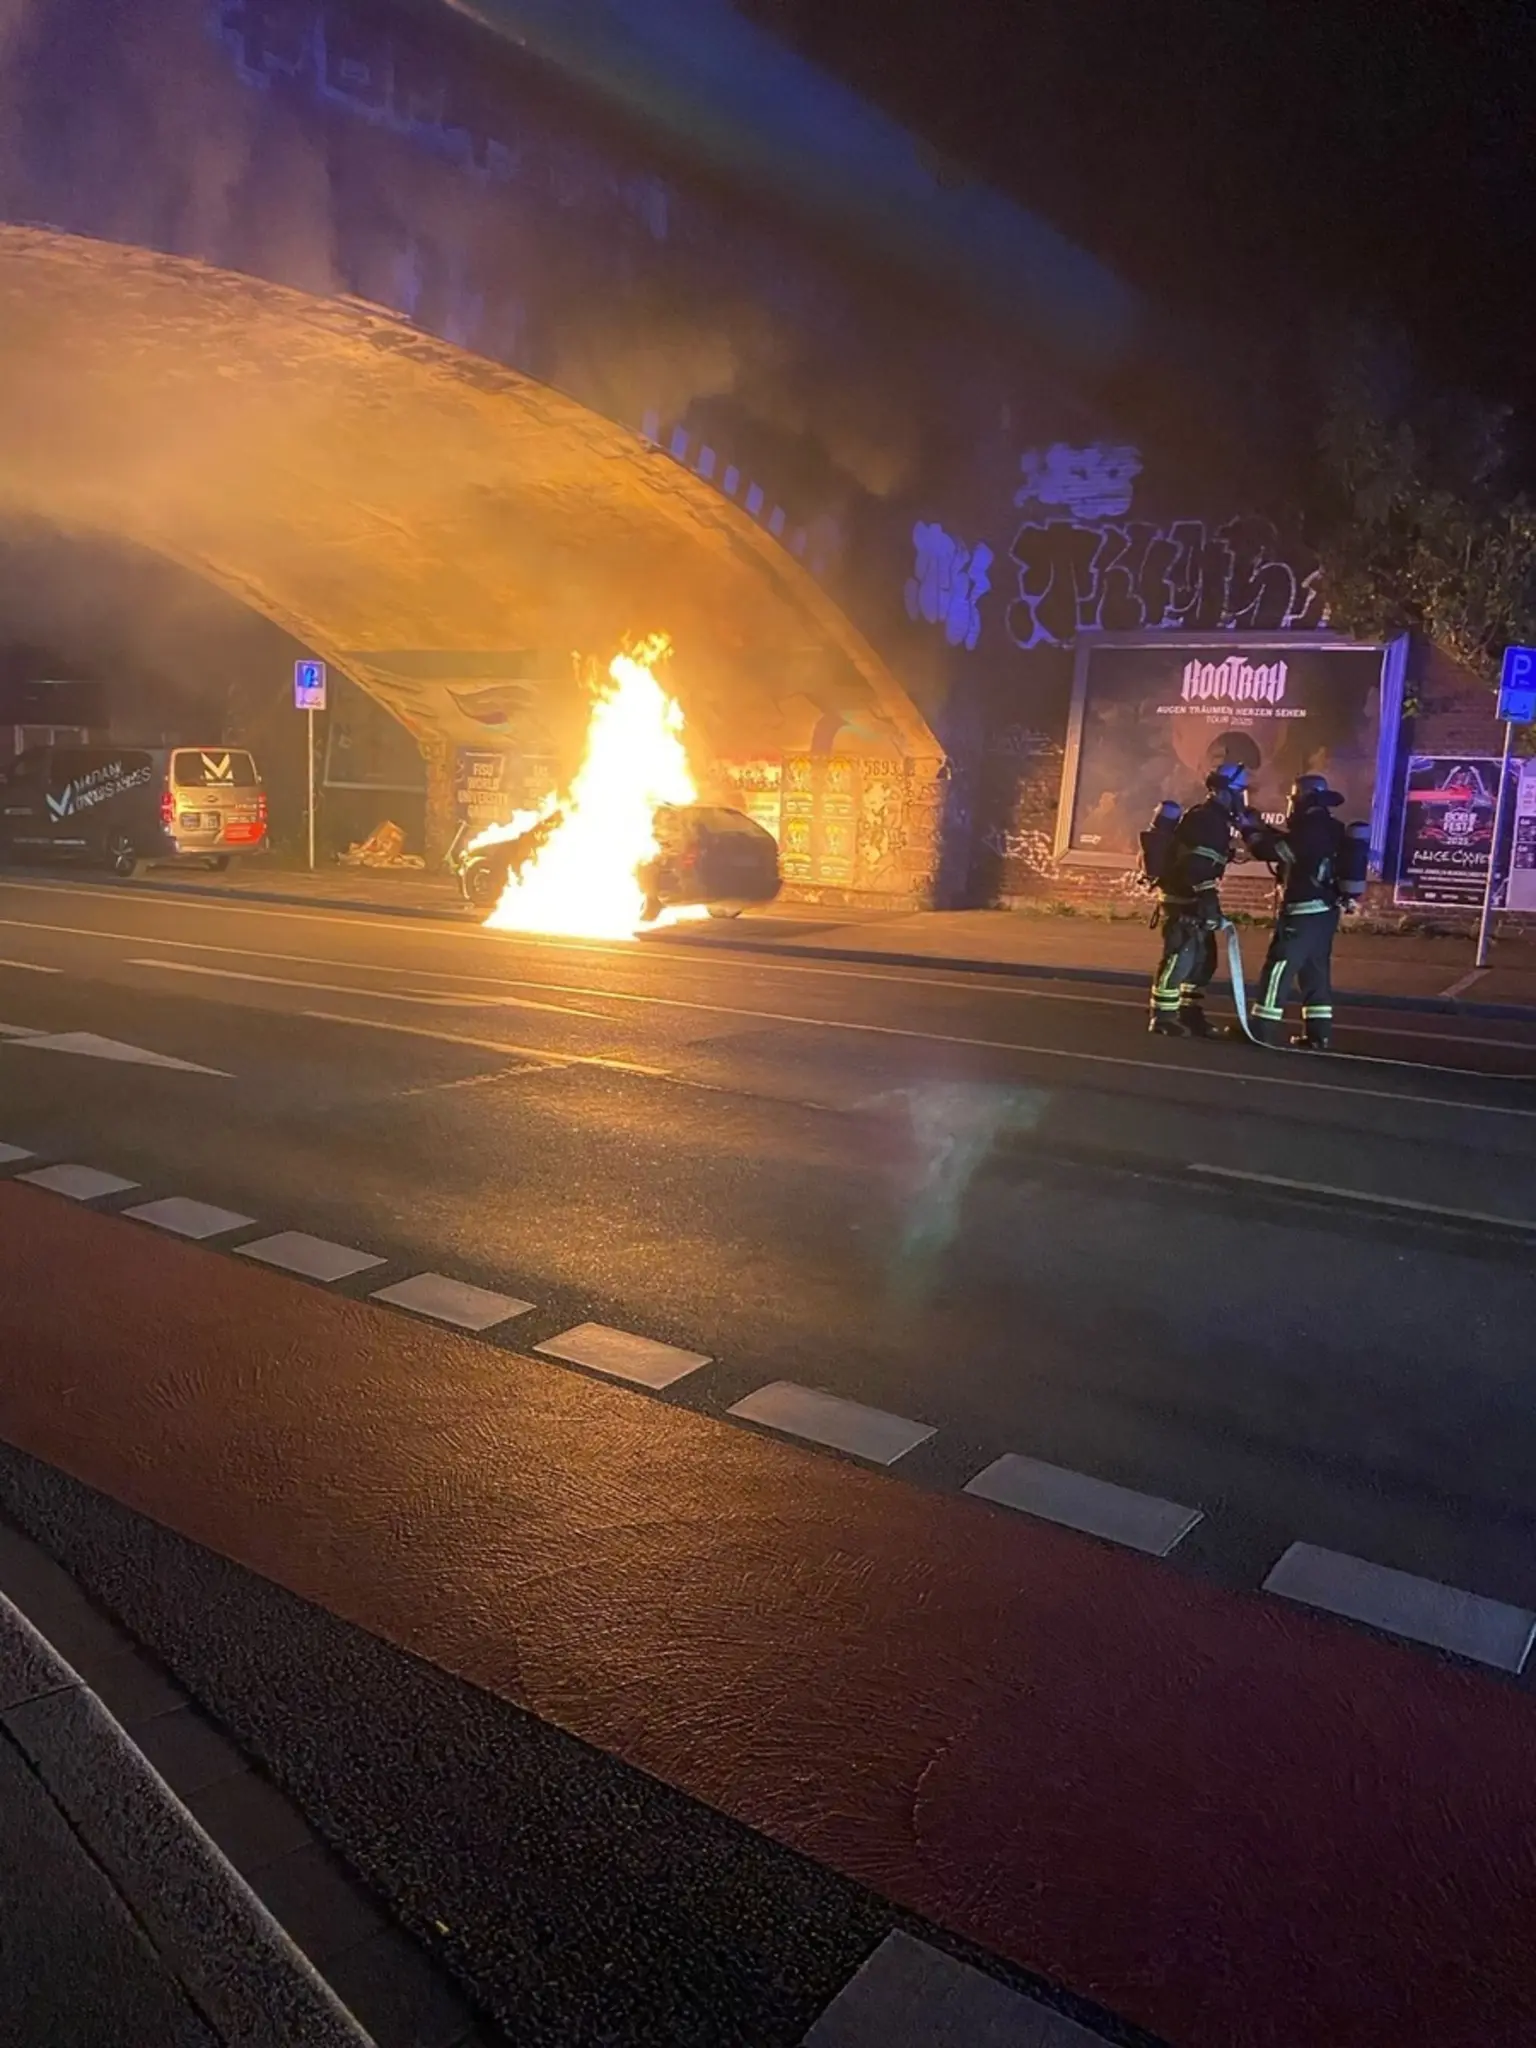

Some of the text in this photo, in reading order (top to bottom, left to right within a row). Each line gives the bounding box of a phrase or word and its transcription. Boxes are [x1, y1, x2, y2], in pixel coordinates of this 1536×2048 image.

[1511, 654, 1532, 687] P
[1156, 705, 1186, 715] AUGEN
[1235, 707, 1273, 717] HERZEN
[1275, 708, 1307, 718] SEHEN
[1206, 715, 1229, 725] TOUR
[467, 776, 500, 791] WORLD
[458, 789, 508, 806] UNIVERSITY
[1412, 849, 1450, 866] ALICE
